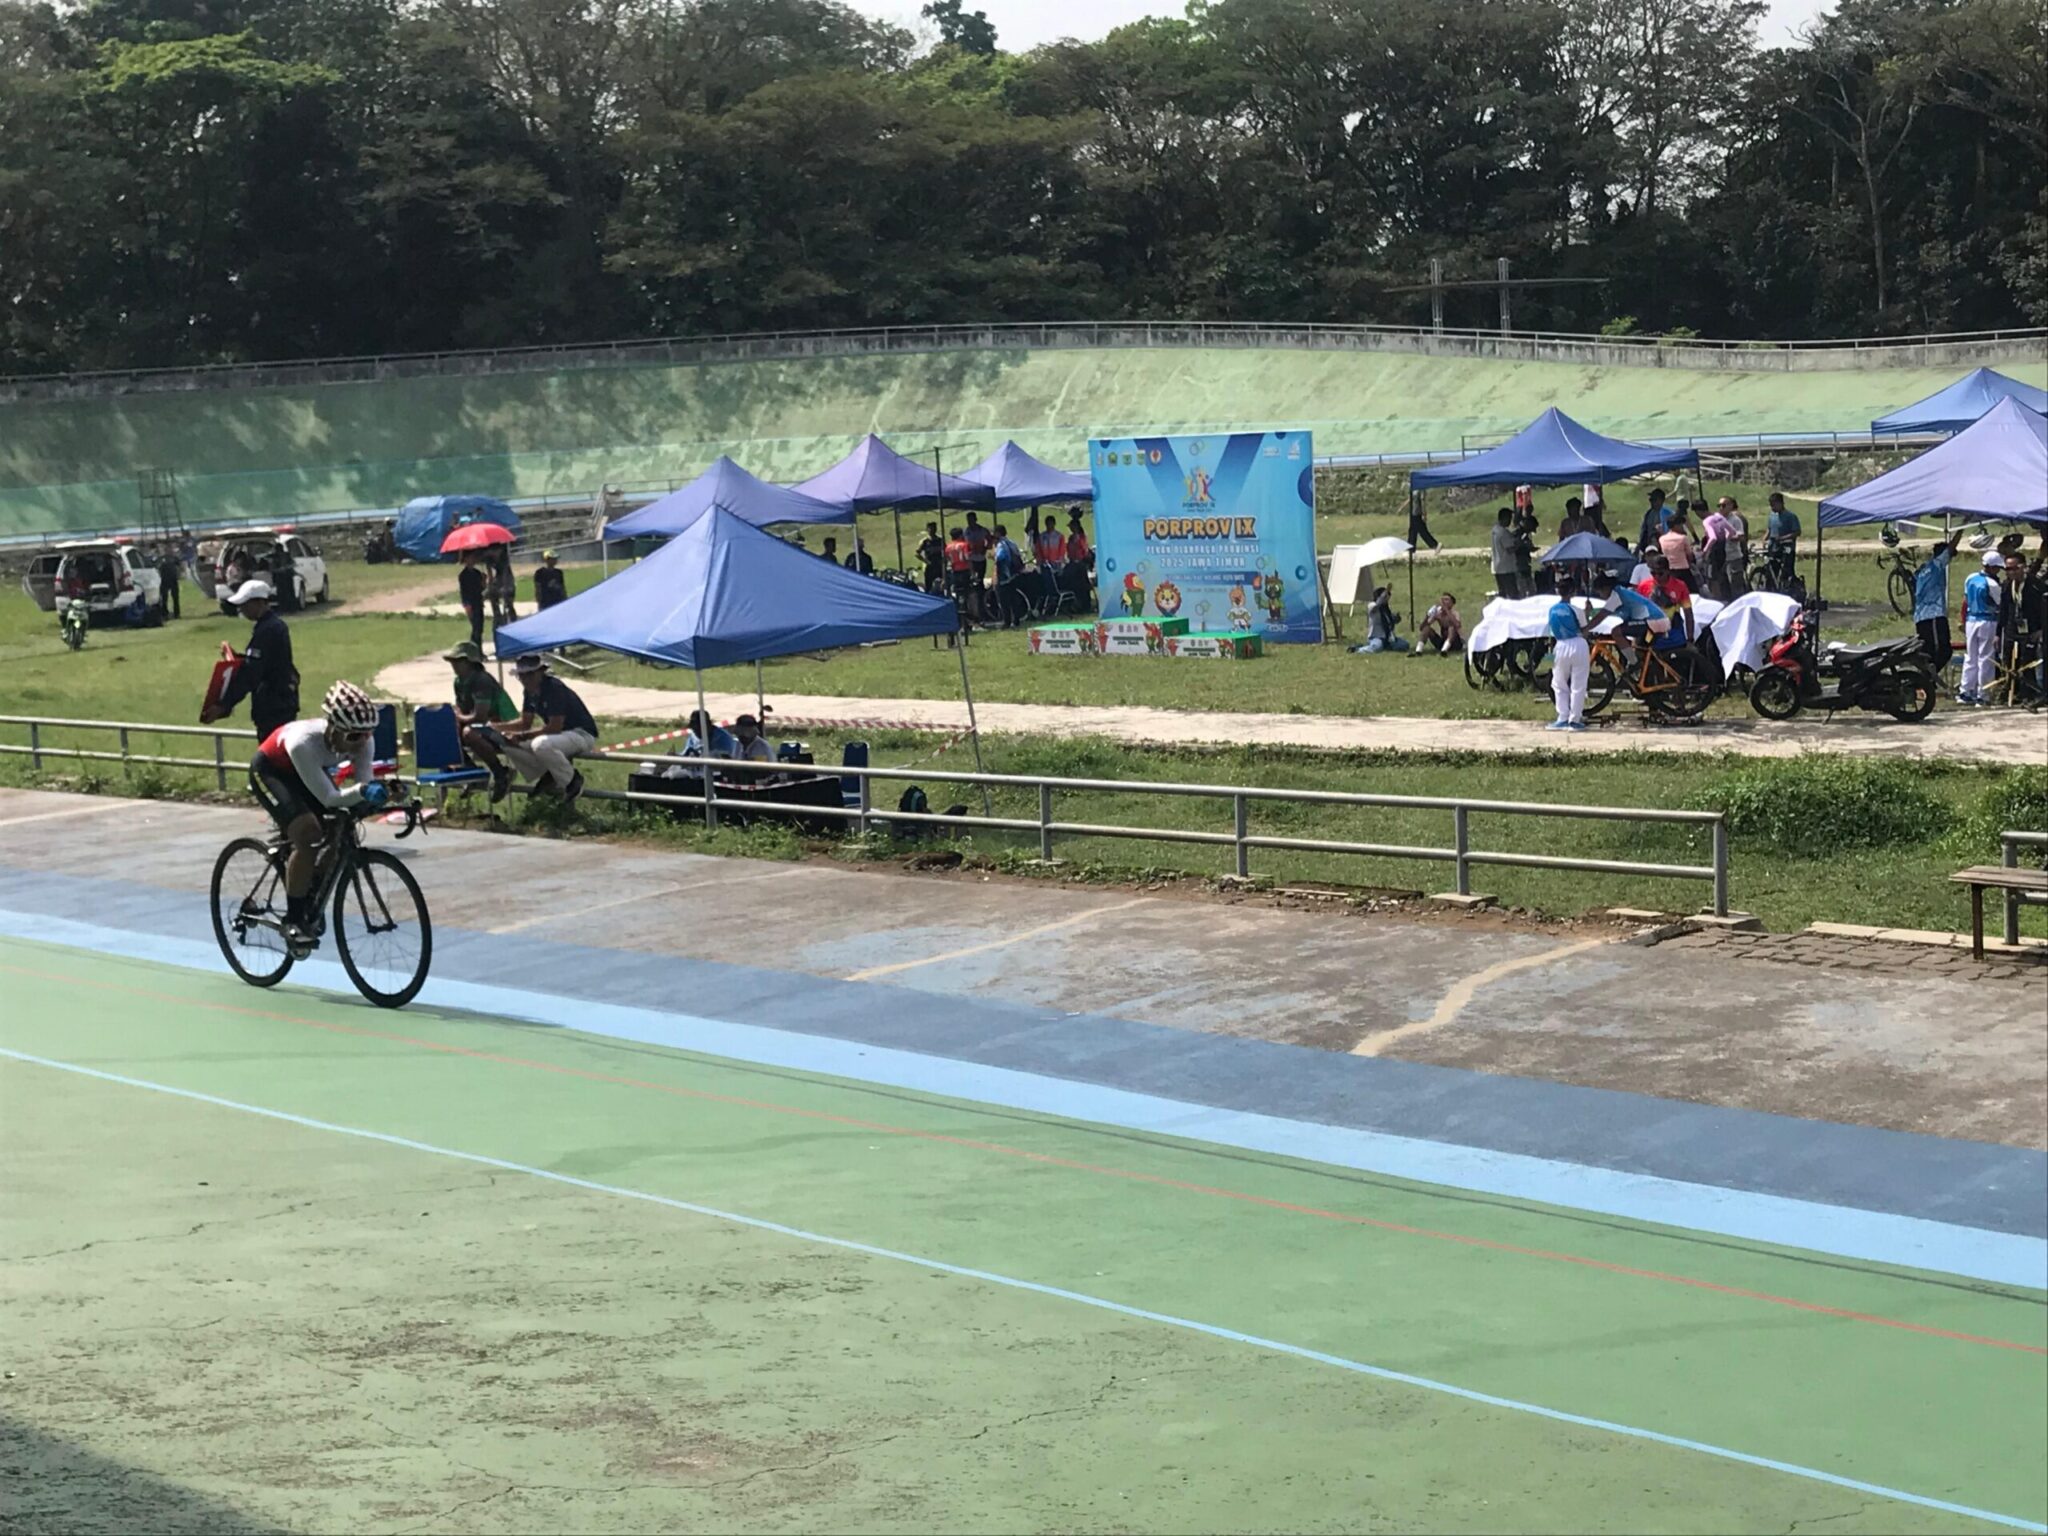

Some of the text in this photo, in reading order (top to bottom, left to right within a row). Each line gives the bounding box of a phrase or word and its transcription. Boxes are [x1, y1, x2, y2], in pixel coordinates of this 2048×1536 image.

[1144, 517, 1257, 540] PORPROV IX
[1218, 545, 1259, 553] PROVINSI
[1161, 558, 1246, 567] 2025 JAWA TIMUR
